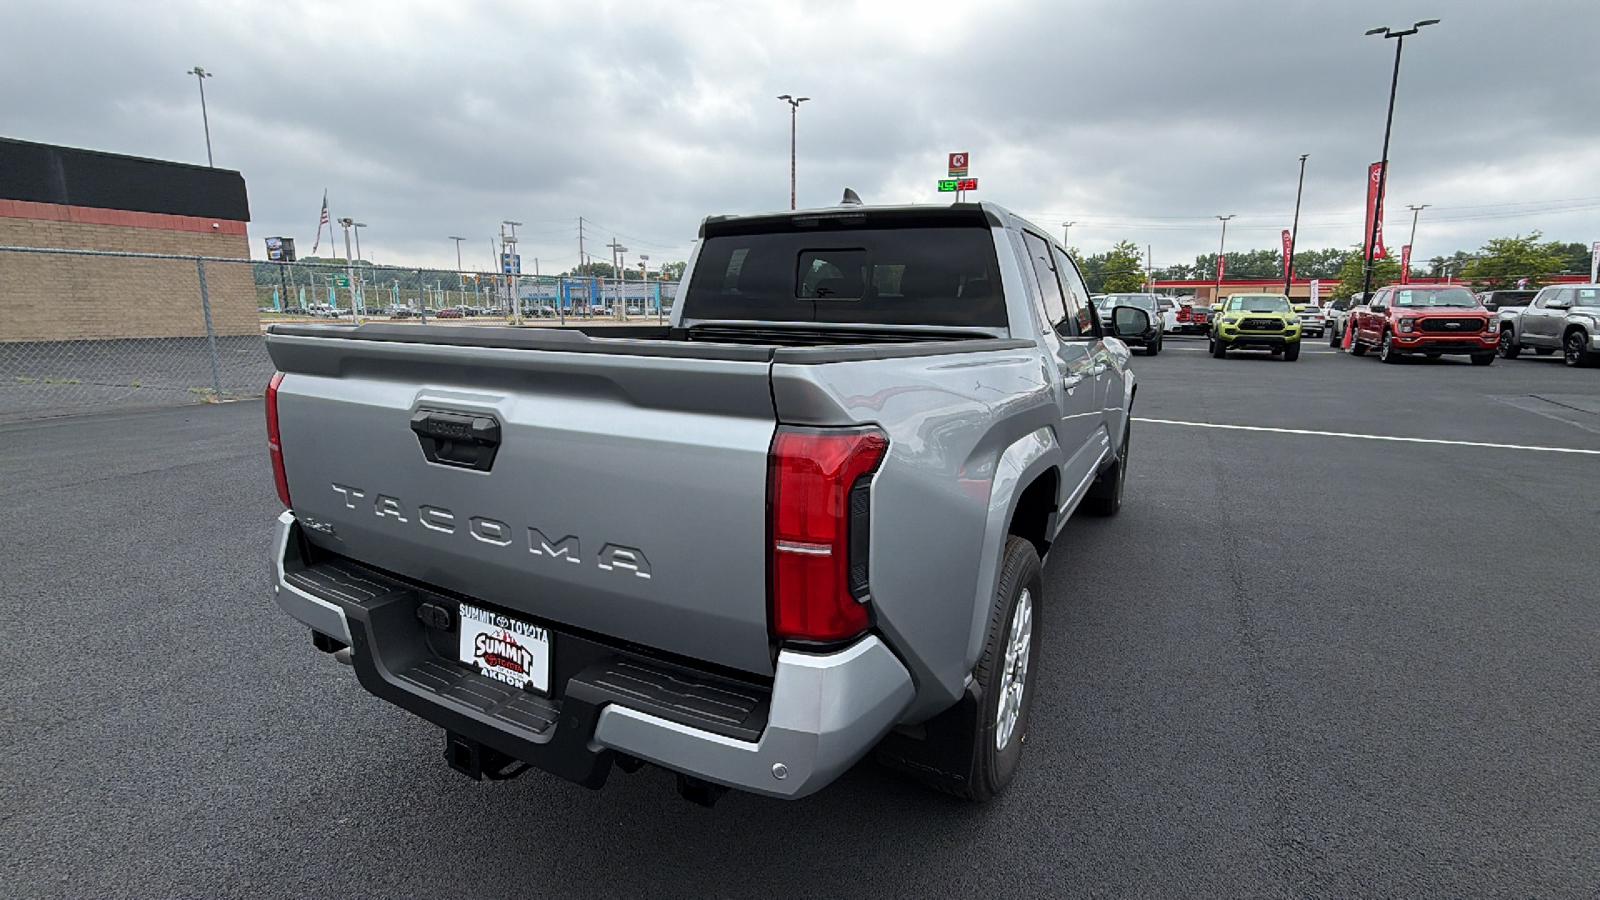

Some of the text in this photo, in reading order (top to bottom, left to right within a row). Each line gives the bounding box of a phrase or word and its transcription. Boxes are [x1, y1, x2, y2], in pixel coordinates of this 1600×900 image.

[430, 422, 471, 437] TOYOTA
[331, 482, 651, 578] TACOMA
[459, 603, 548, 643] SUMMIT TOYOTA
[476, 635, 532, 673] SUMMIT
[498, 658, 522, 672] TOYOTA
[481, 667, 524, 689] AKRON
